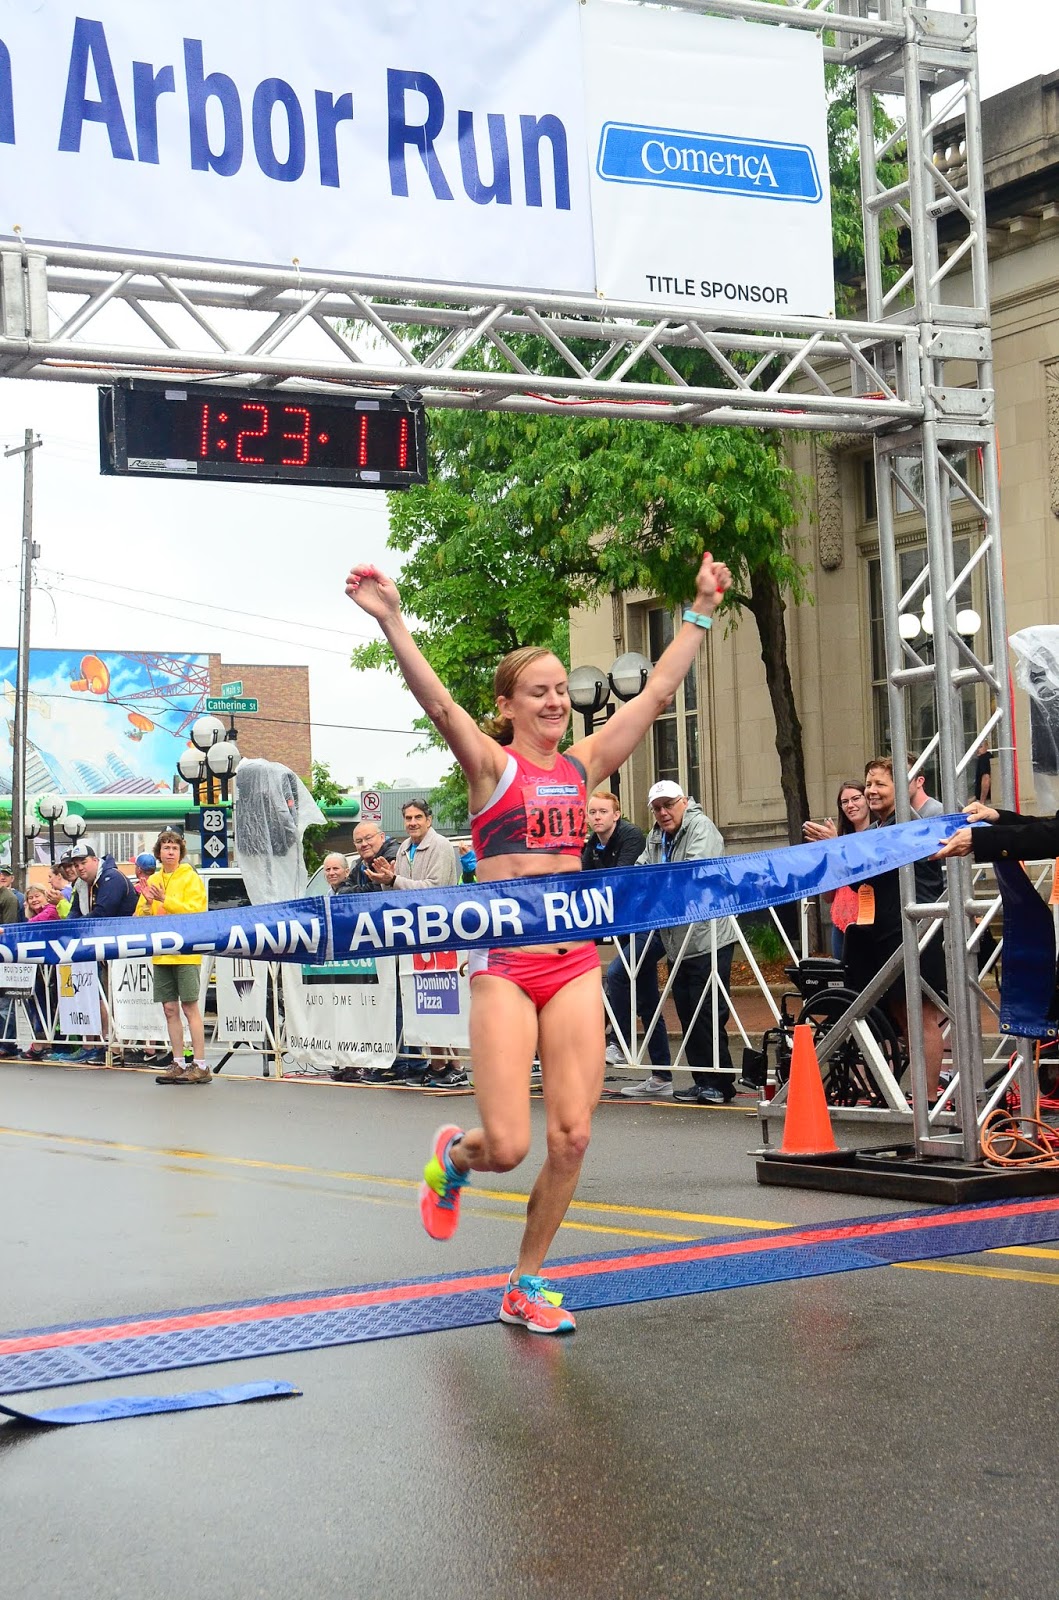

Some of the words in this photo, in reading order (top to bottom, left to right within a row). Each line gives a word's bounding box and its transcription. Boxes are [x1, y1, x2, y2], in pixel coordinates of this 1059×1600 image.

[58, 17, 353, 189] Arbor
[387, 68, 571, 210] Run
[645, 275, 696, 296] TITLE
[700, 281, 789, 304] SPONSOR
[208, 700, 246, 710] Catherine
[206, 814, 222, 827] 23
[530, 807, 586, 838] 3012
[209, 843, 220, 852] 14
[349, 898, 524, 951] ARBOR
[543, 886, 615, 932] RUN
[416, 974, 457, 990] Domino's
[361, 993, 376, 1006] LIE
[417, 992, 443, 1009] Pizza
